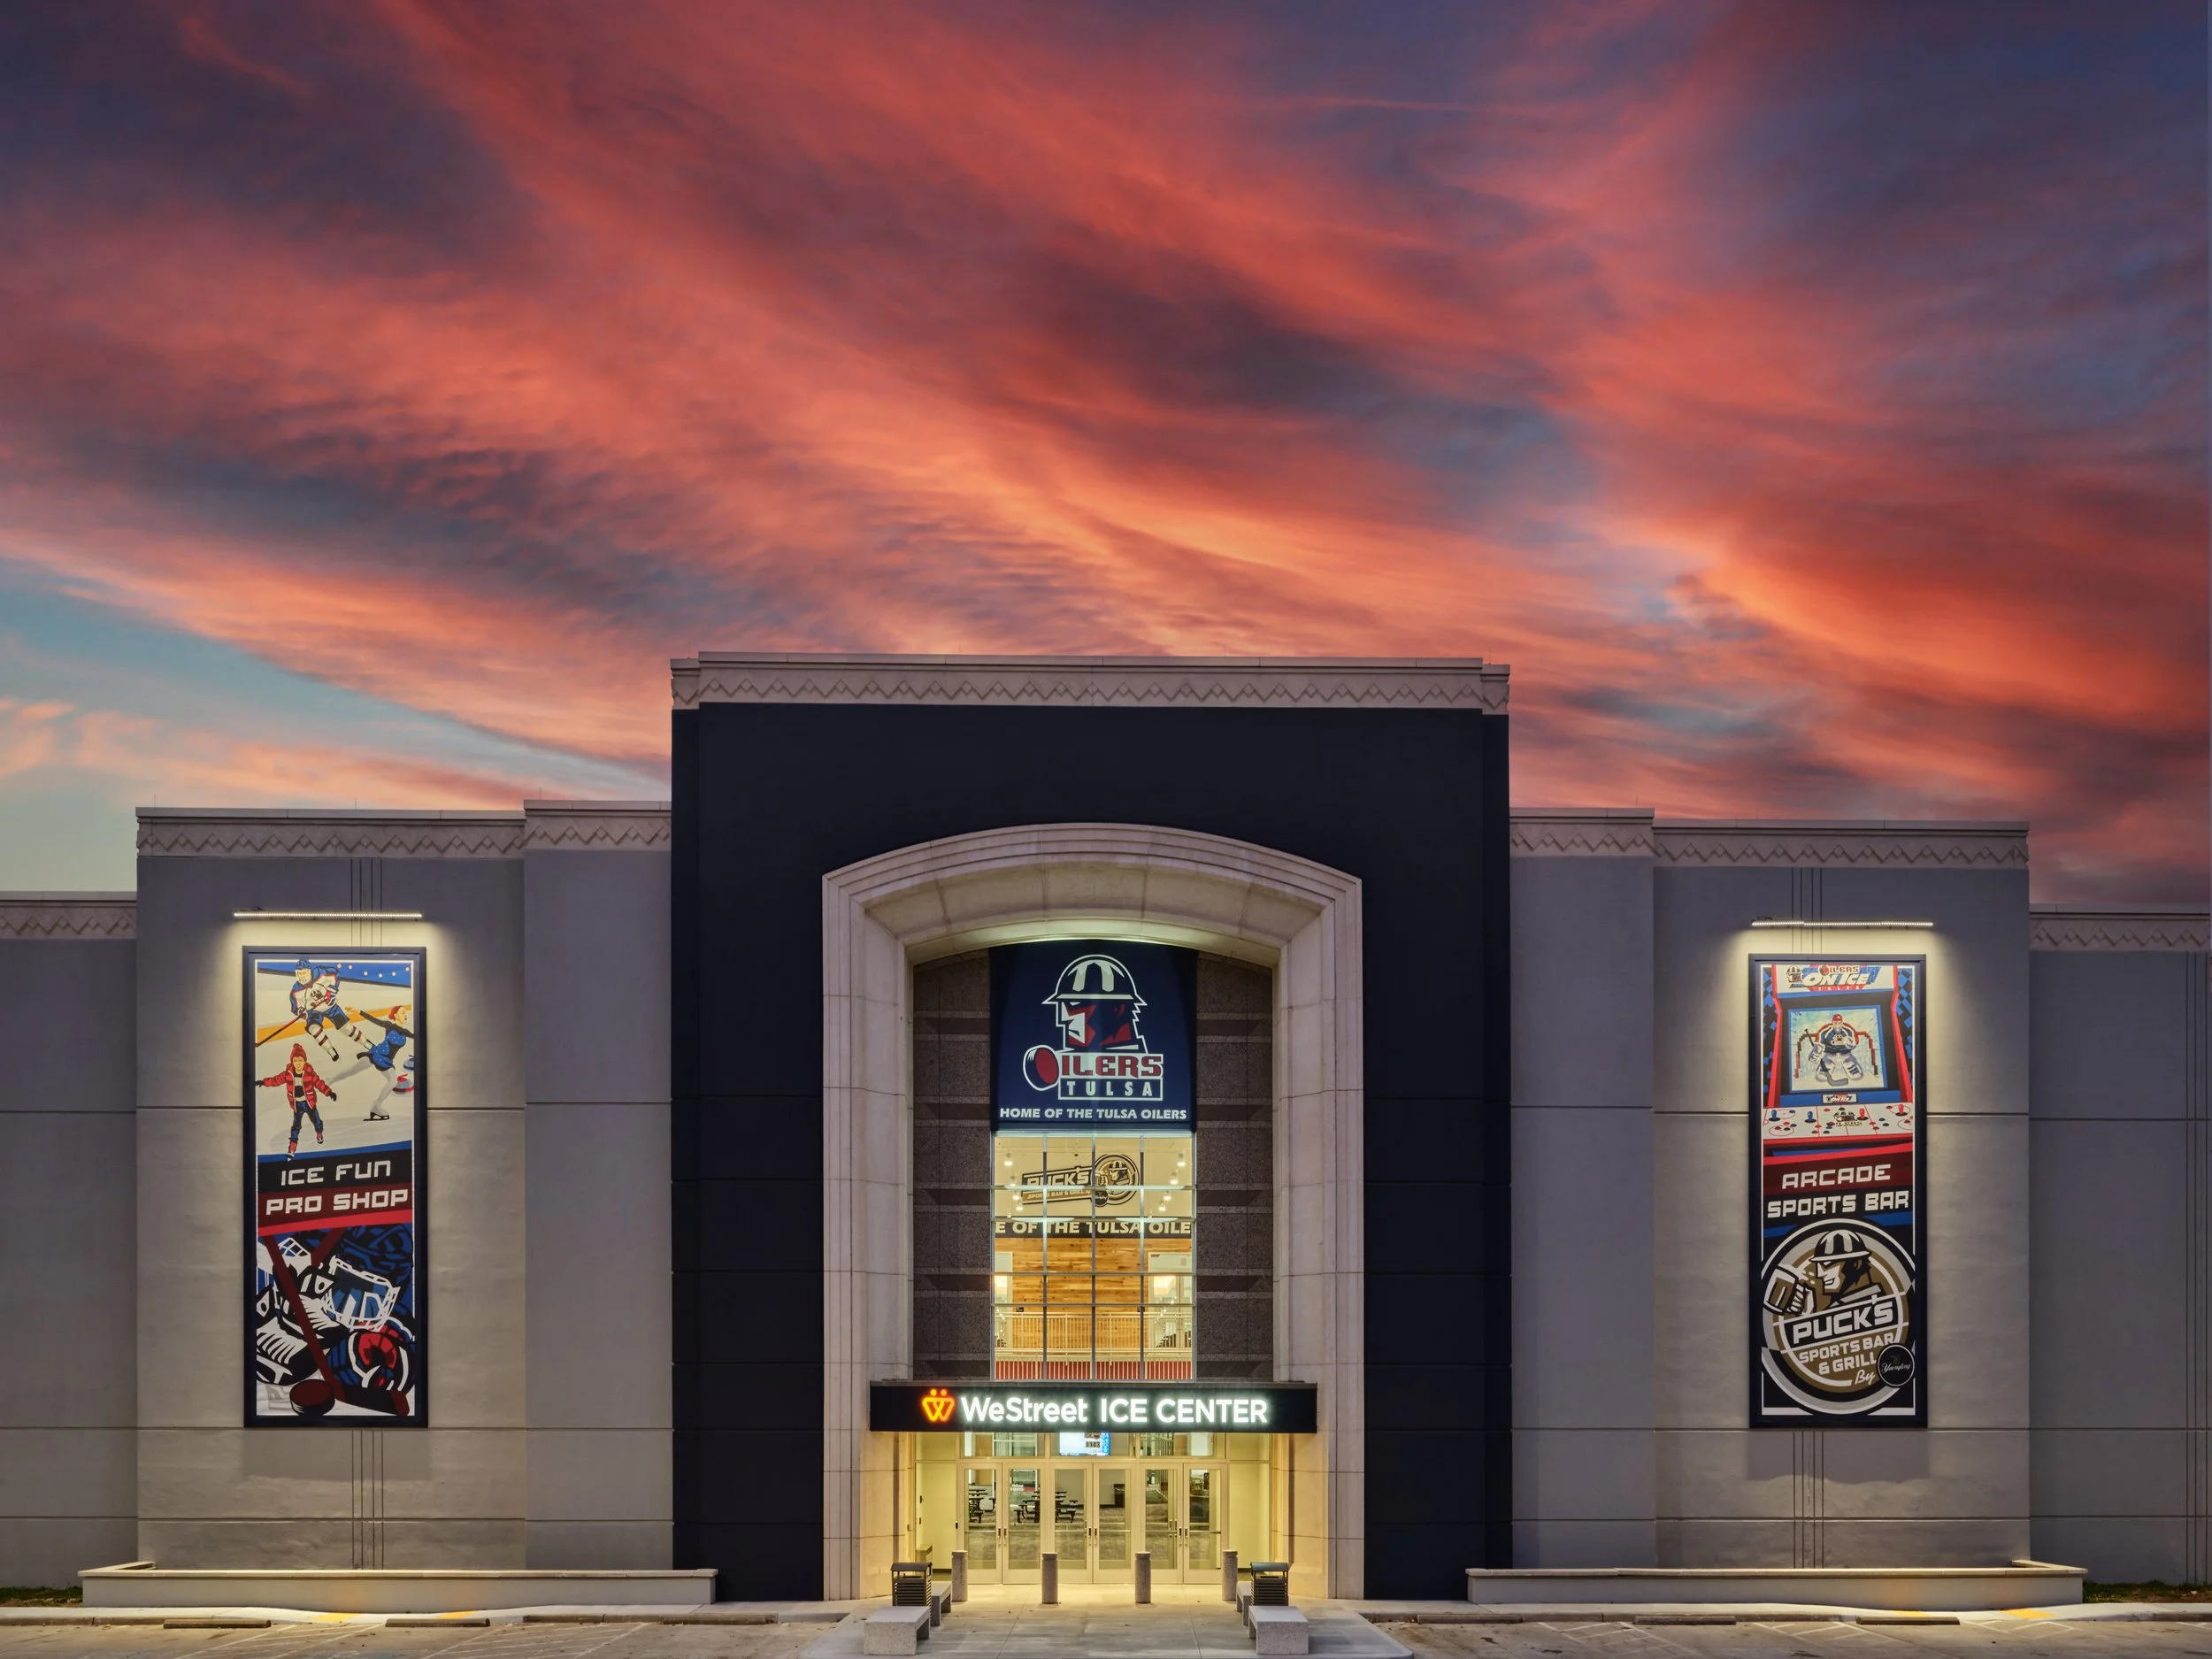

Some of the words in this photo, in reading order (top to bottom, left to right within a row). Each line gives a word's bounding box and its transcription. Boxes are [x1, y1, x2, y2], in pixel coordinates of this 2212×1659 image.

[1066, 1081, 1152, 1096] TULSA
[1000, 1109, 1040, 1118] HOME
[1044, 1109, 1062, 1118] OF
[1067, 1109, 1092, 1118] THE
[1096, 1109, 1137, 1119] TULSA
[1141, 1110, 1187, 1119] OILERS
[281, 1167, 324, 1186] ICE
[335, 1160, 390, 1180] FUN
[1782, 1164, 1891, 1189] ARCADE
[266, 1195, 322, 1215] PRO
[334, 1189, 408, 1210] SHOP
[1767, 1194, 1856, 1218] SPORTS
[1865, 1190, 1909, 1211] BAR
[1012, 1221, 1038, 1233] OF
[1799, 1340, 1859, 1363] SPORTS
[1863, 1333, 1893, 1348] BAR
[1818, 1362, 1830, 1375] &
[1832, 1352, 1877, 1372] GRILL
[1855, 1370, 1875, 1385] By
[961, 1397, 1087, 1423] WeStreet
[1102, 1398, 1148, 1423] ICE
[1156, 1398, 1268, 1423] CENTER
